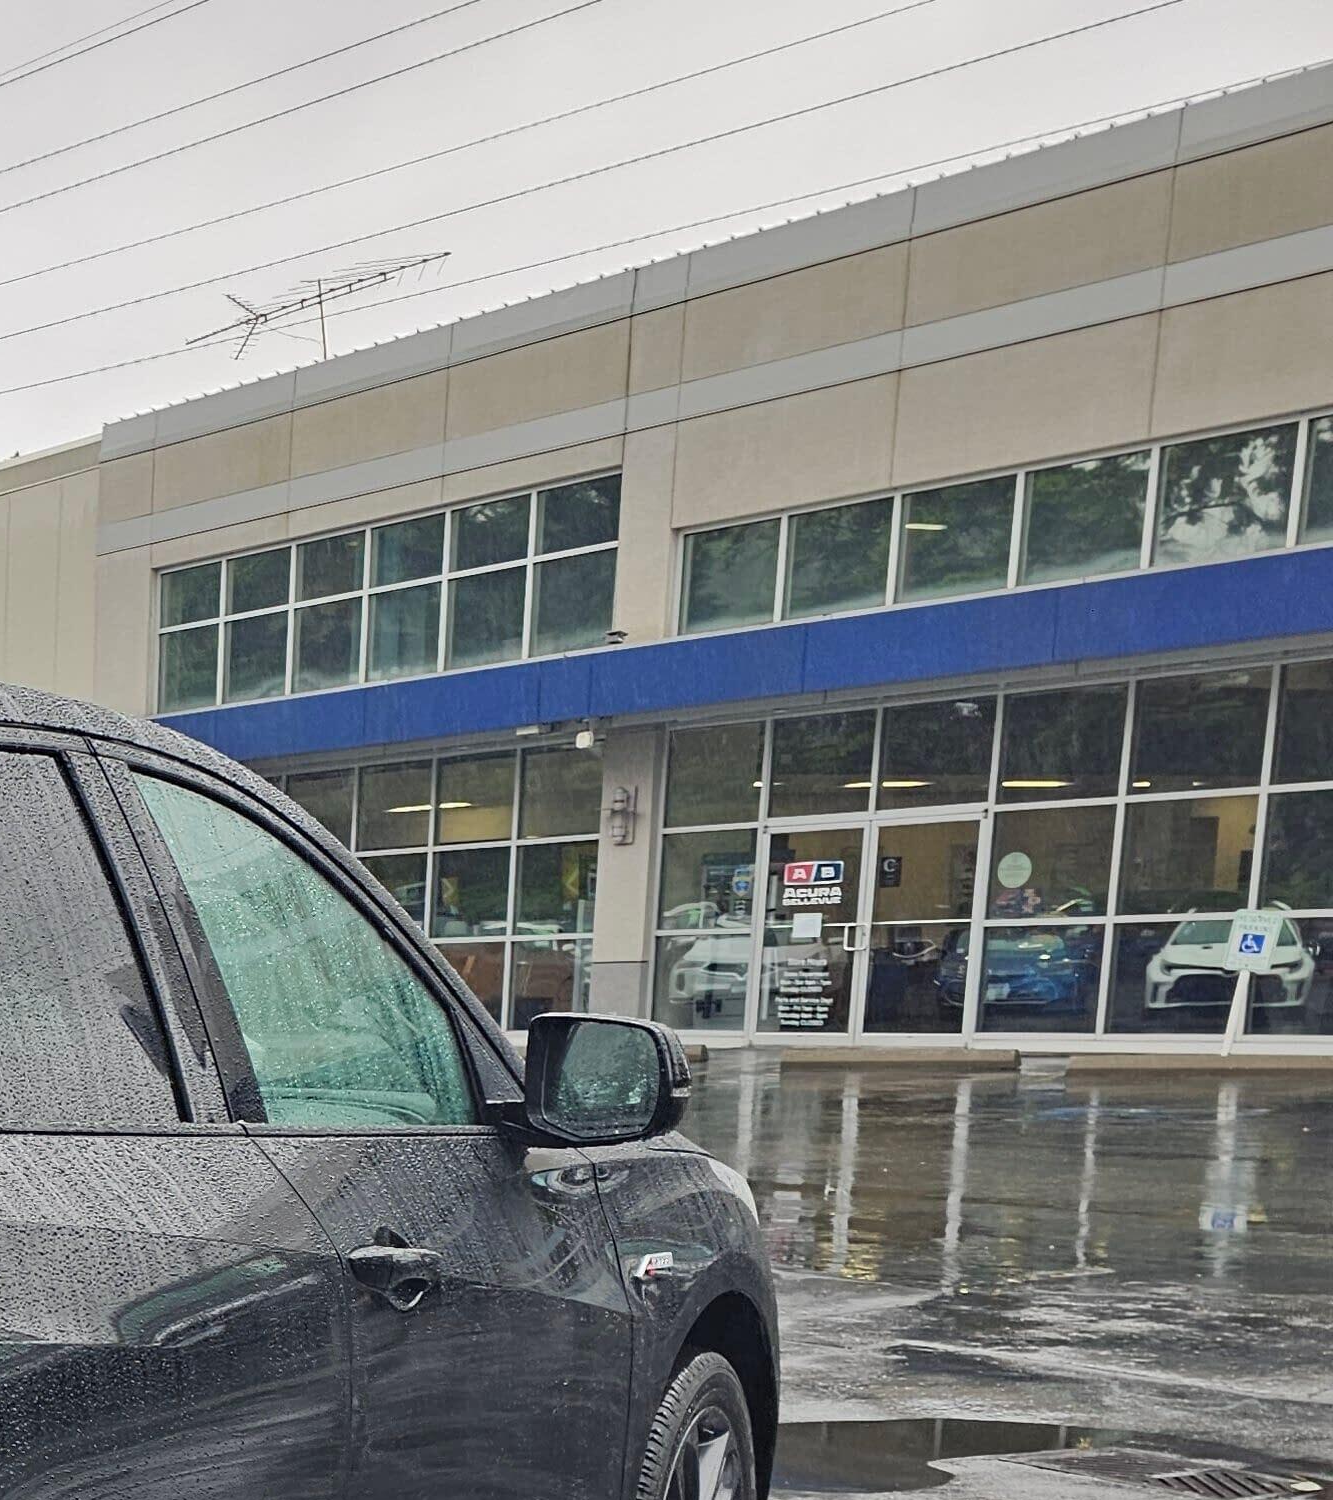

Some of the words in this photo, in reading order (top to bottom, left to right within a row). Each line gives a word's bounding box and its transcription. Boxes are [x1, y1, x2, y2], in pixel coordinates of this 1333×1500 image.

[792, 868, 808, 880] A
[820, 866, 836, 879] B
[782, 886, 843, 899] ACURA
